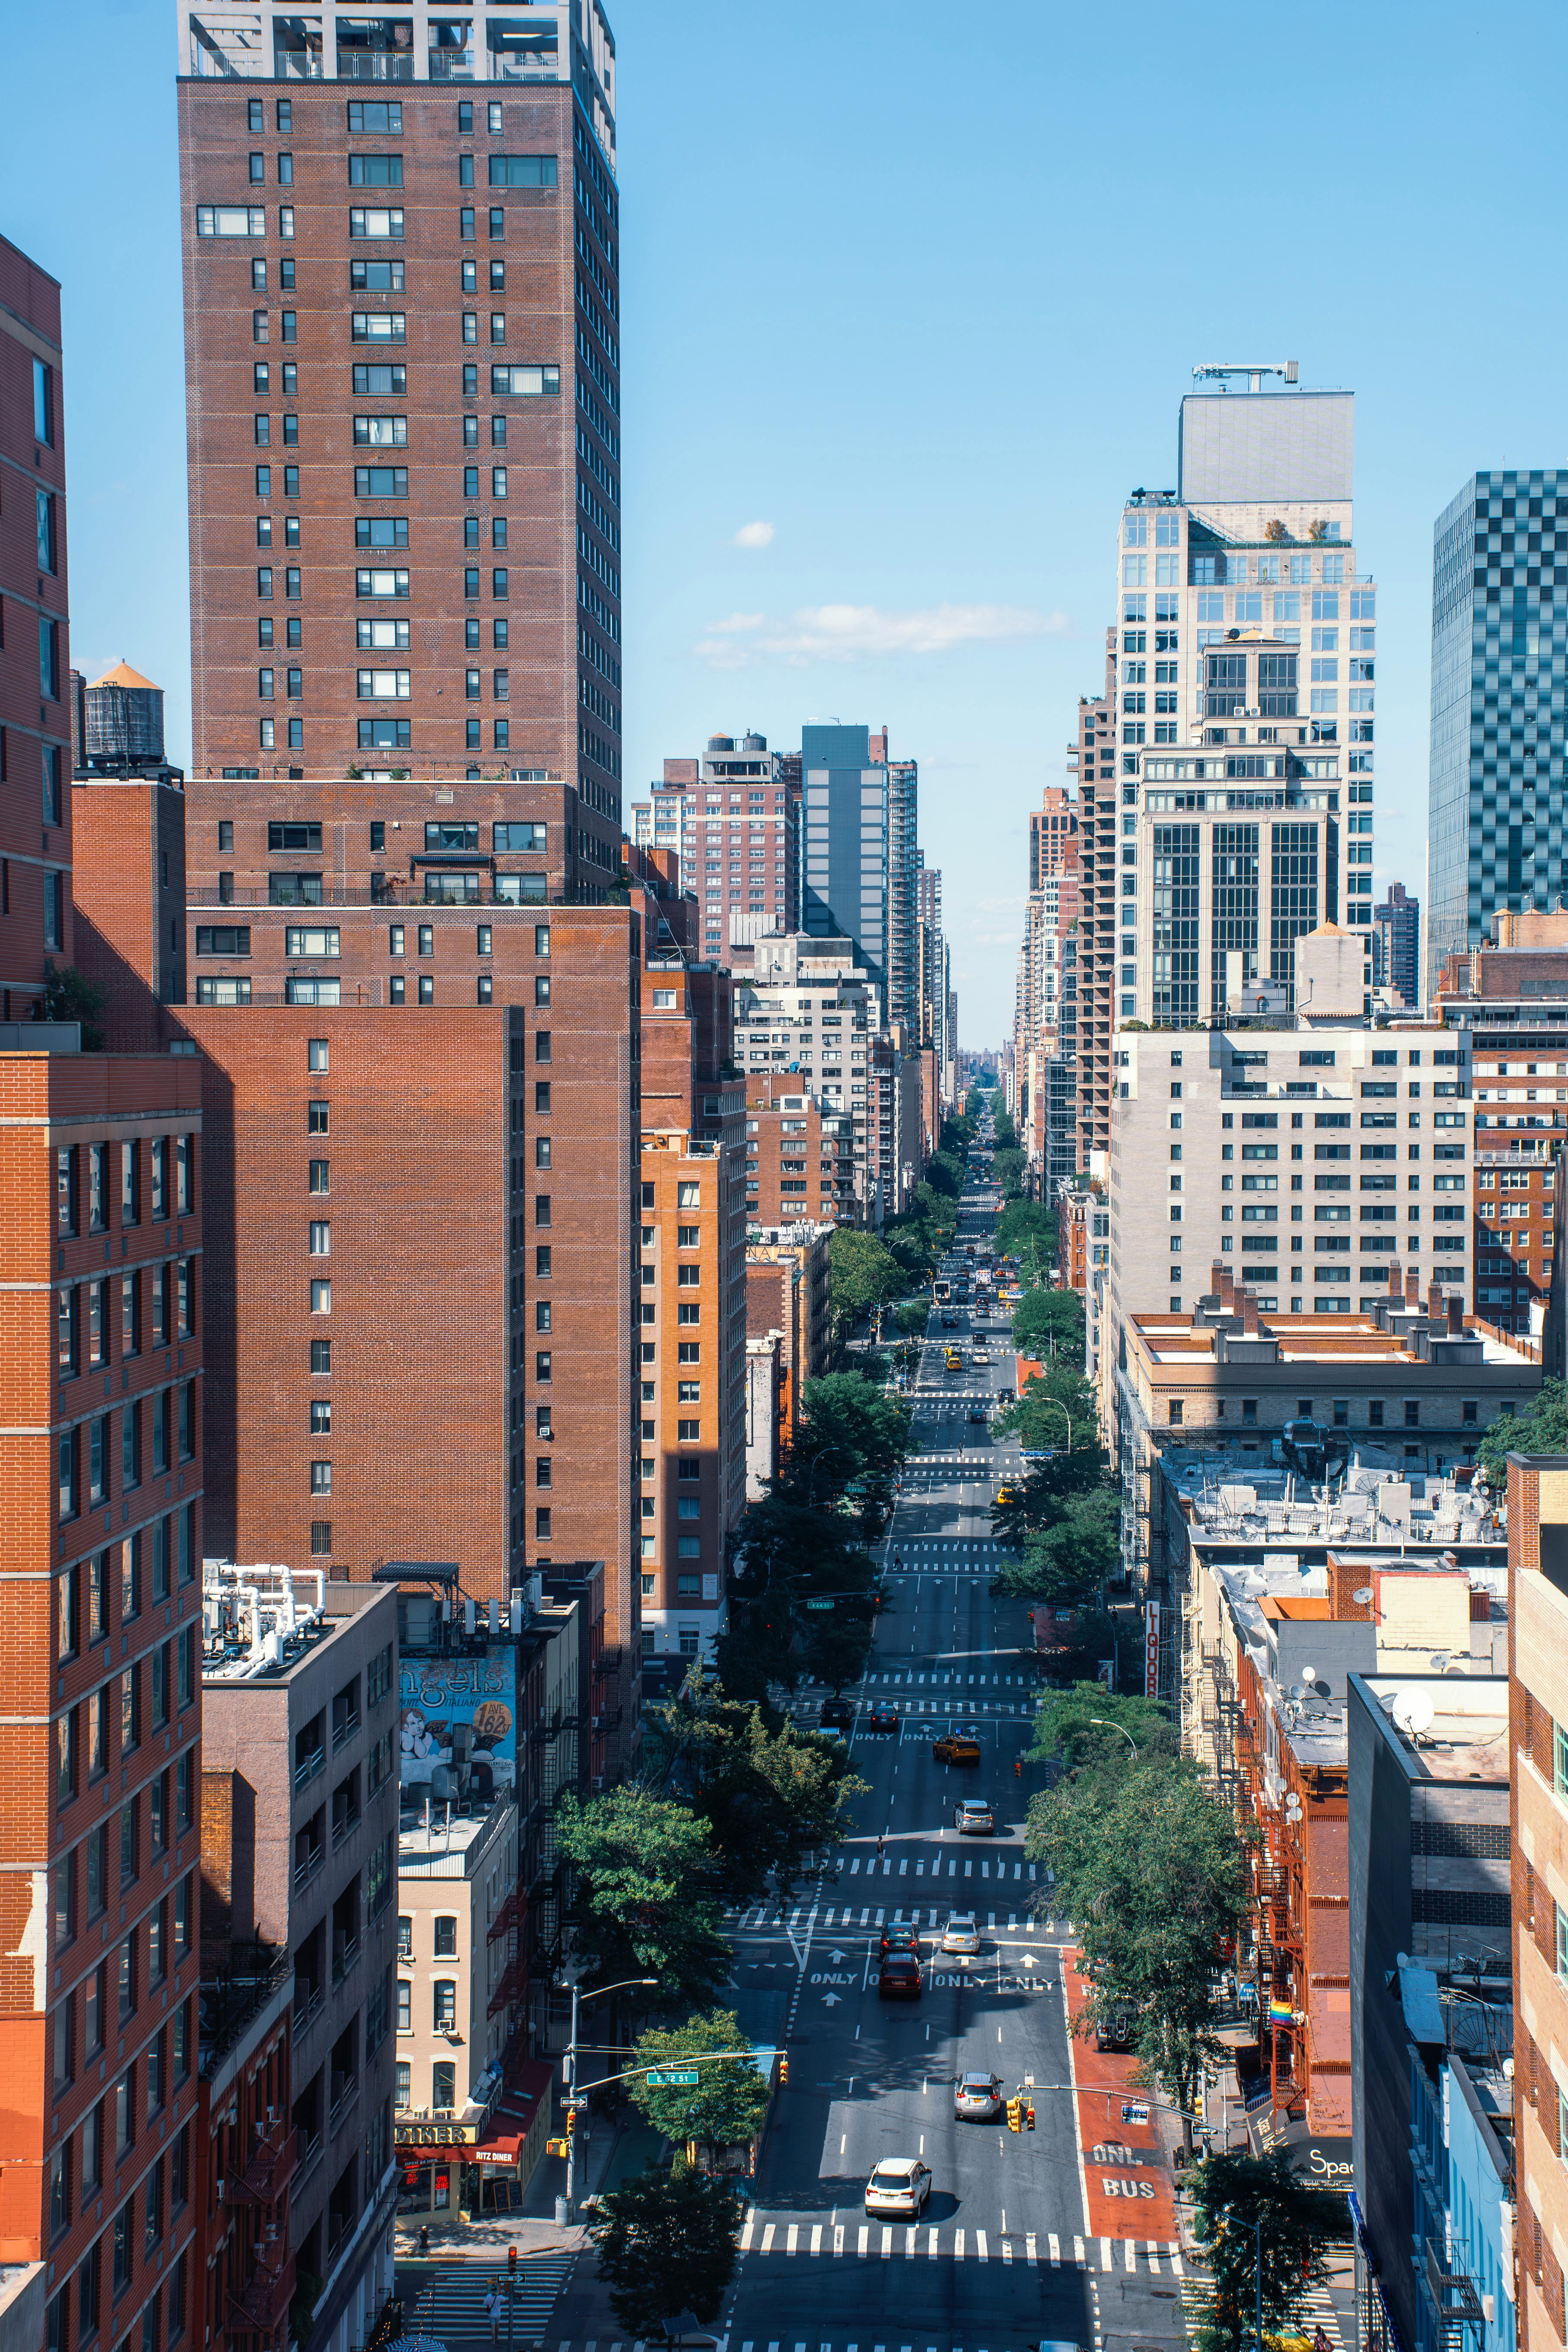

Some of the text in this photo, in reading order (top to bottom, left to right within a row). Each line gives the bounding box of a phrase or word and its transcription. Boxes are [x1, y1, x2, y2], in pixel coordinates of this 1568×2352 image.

[445, 1698, 481, 1707] ITALIANO
[478, 1703, 505, 1726] 1 AVE
[484, 1715, 505, 1733] 62
[810, 1973, 858, 1984] ONLY
[935, 1975, 987, 1987] ONLY
[396, 2126, 465, 2144] DINER
[476, 2151, 512, 2162] RITZ DINER
[1102, 2178, 1155, 2198] BUS
